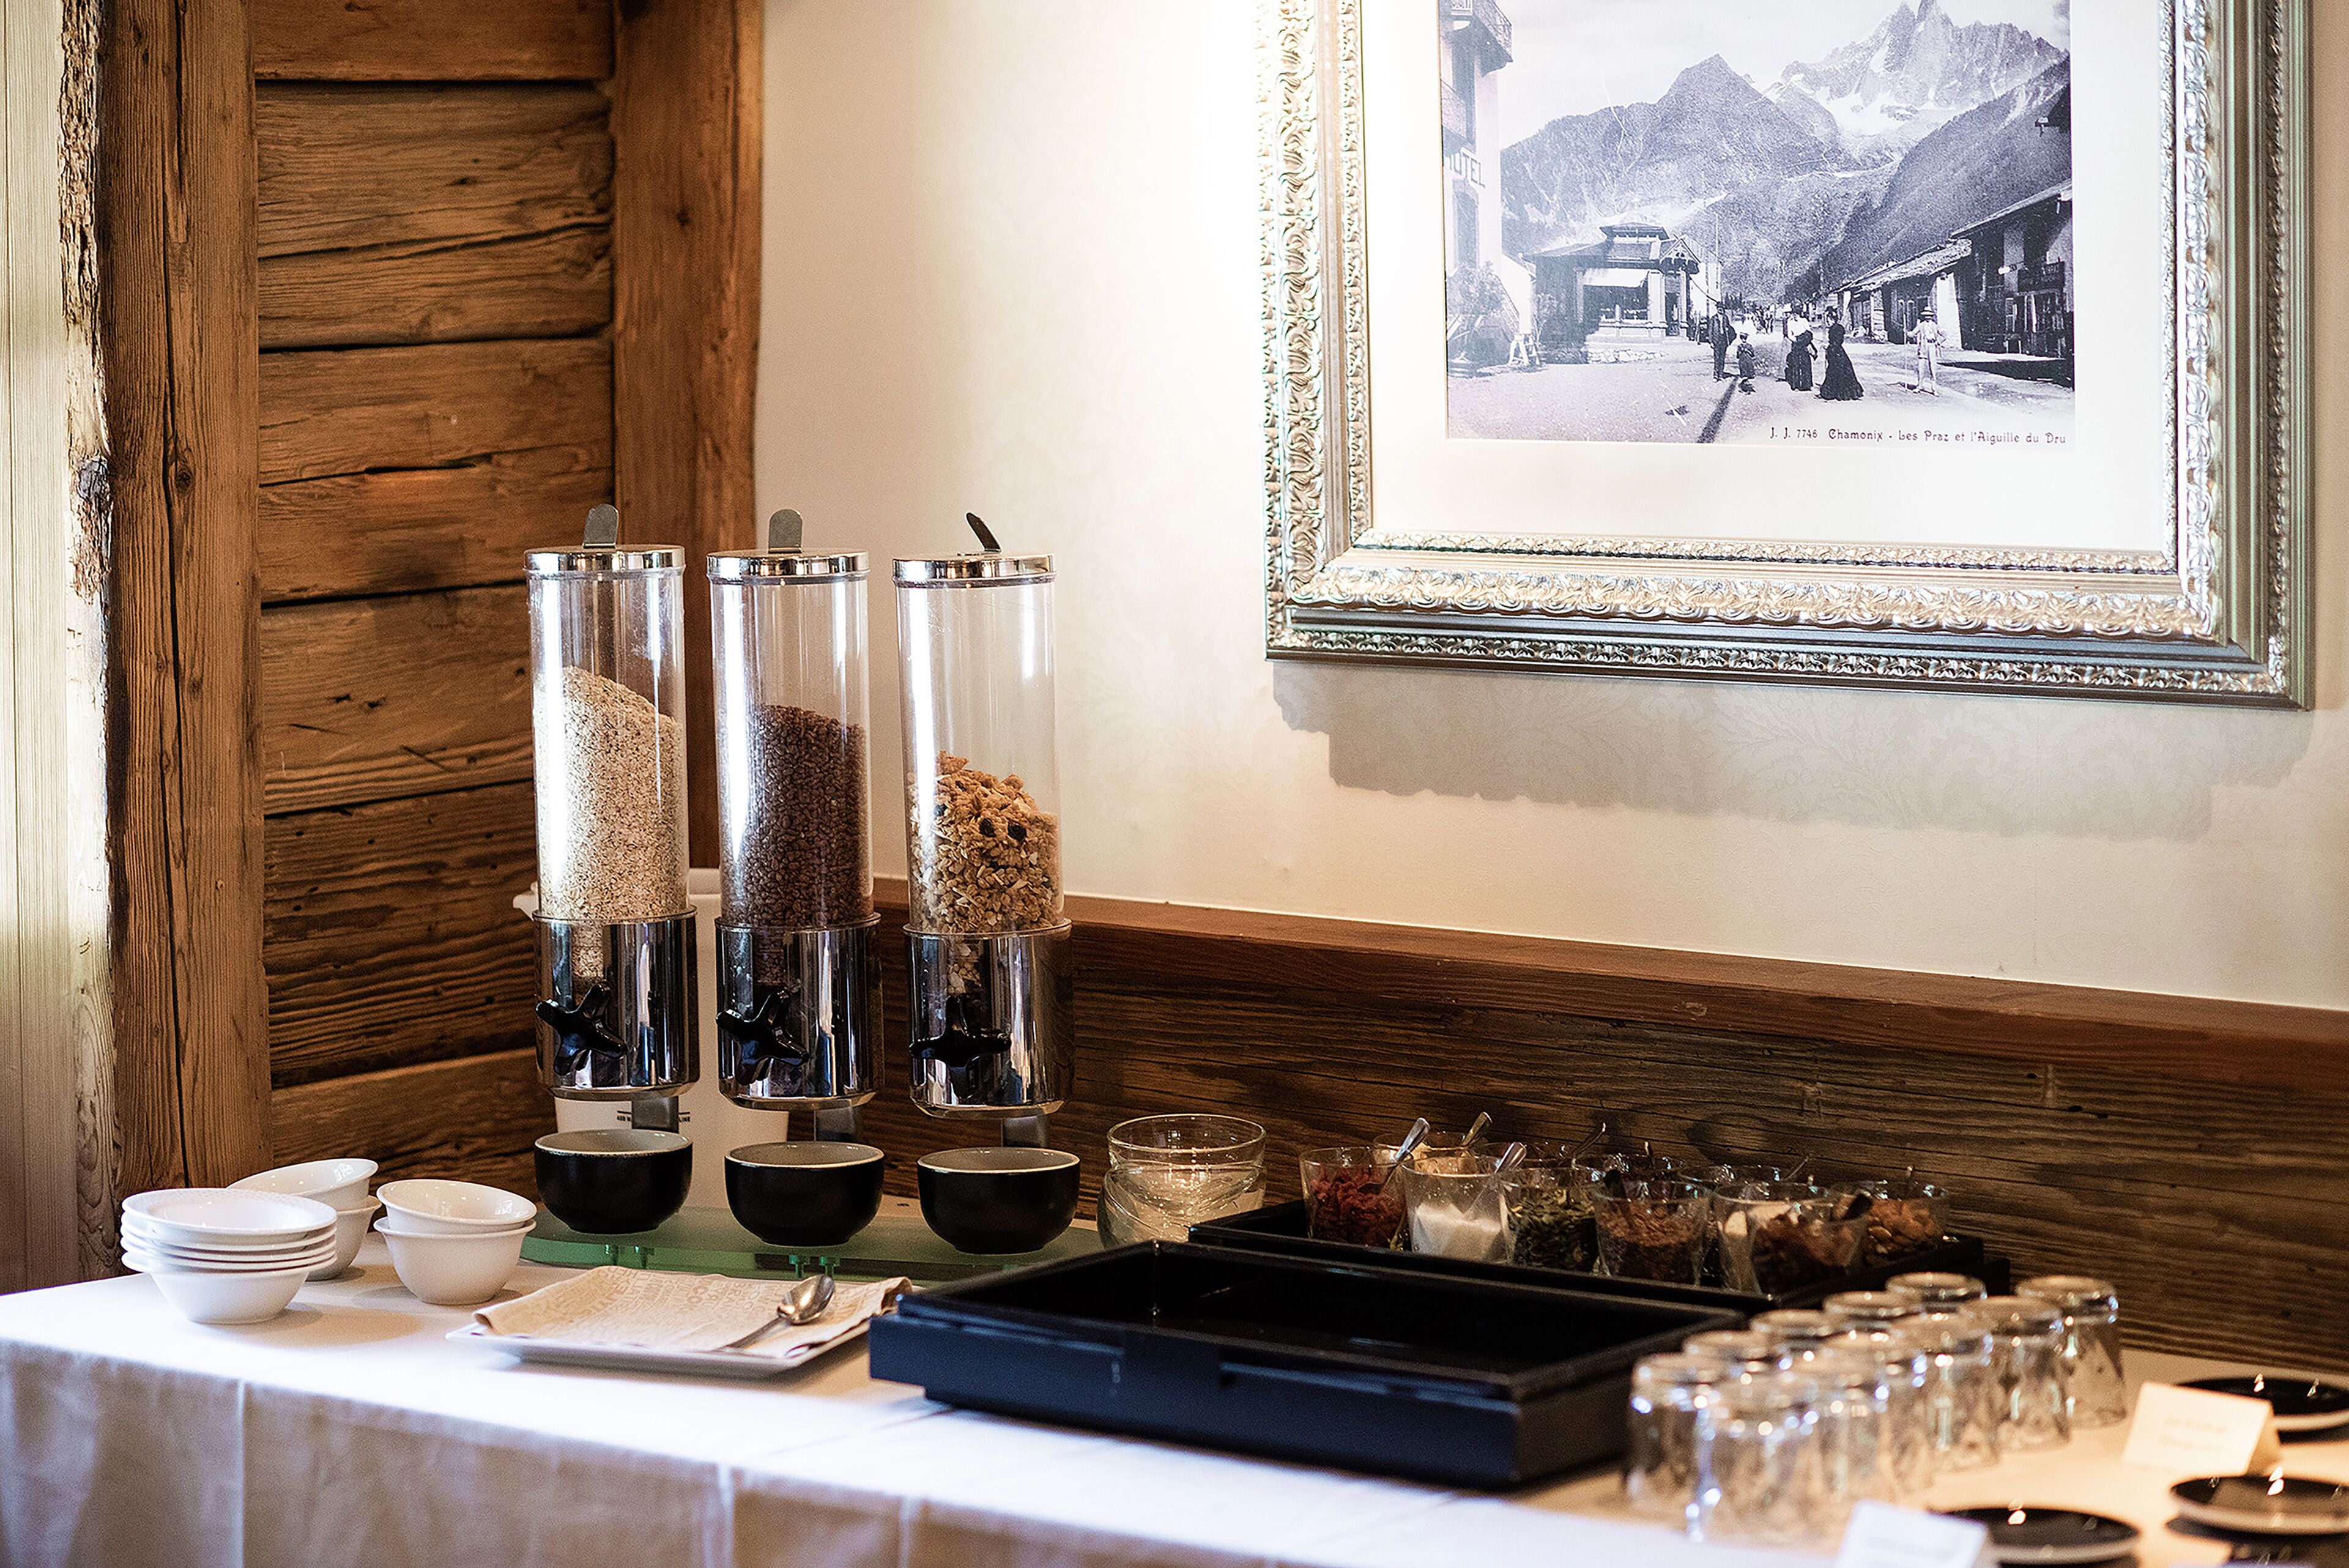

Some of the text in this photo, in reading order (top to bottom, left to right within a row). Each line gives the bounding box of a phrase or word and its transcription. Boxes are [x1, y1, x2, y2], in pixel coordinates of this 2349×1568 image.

[1770, 427, 1778, 439] J.
[1784, 428, 1791, 439] J.
[1797, 429, 1818, 438] 7746
[1828, 429, 1883, 442] Chamonix
[1899, 430, 1918, 440] Les
[1924, 430, 1949, 441] Praz
[1955, 431, 1965, 441] et
[1970, 431, 2020, 445] l'Aiguille
[2025, 433, 2039, 443] du
[2045, 433, 2066, 444] Dru
